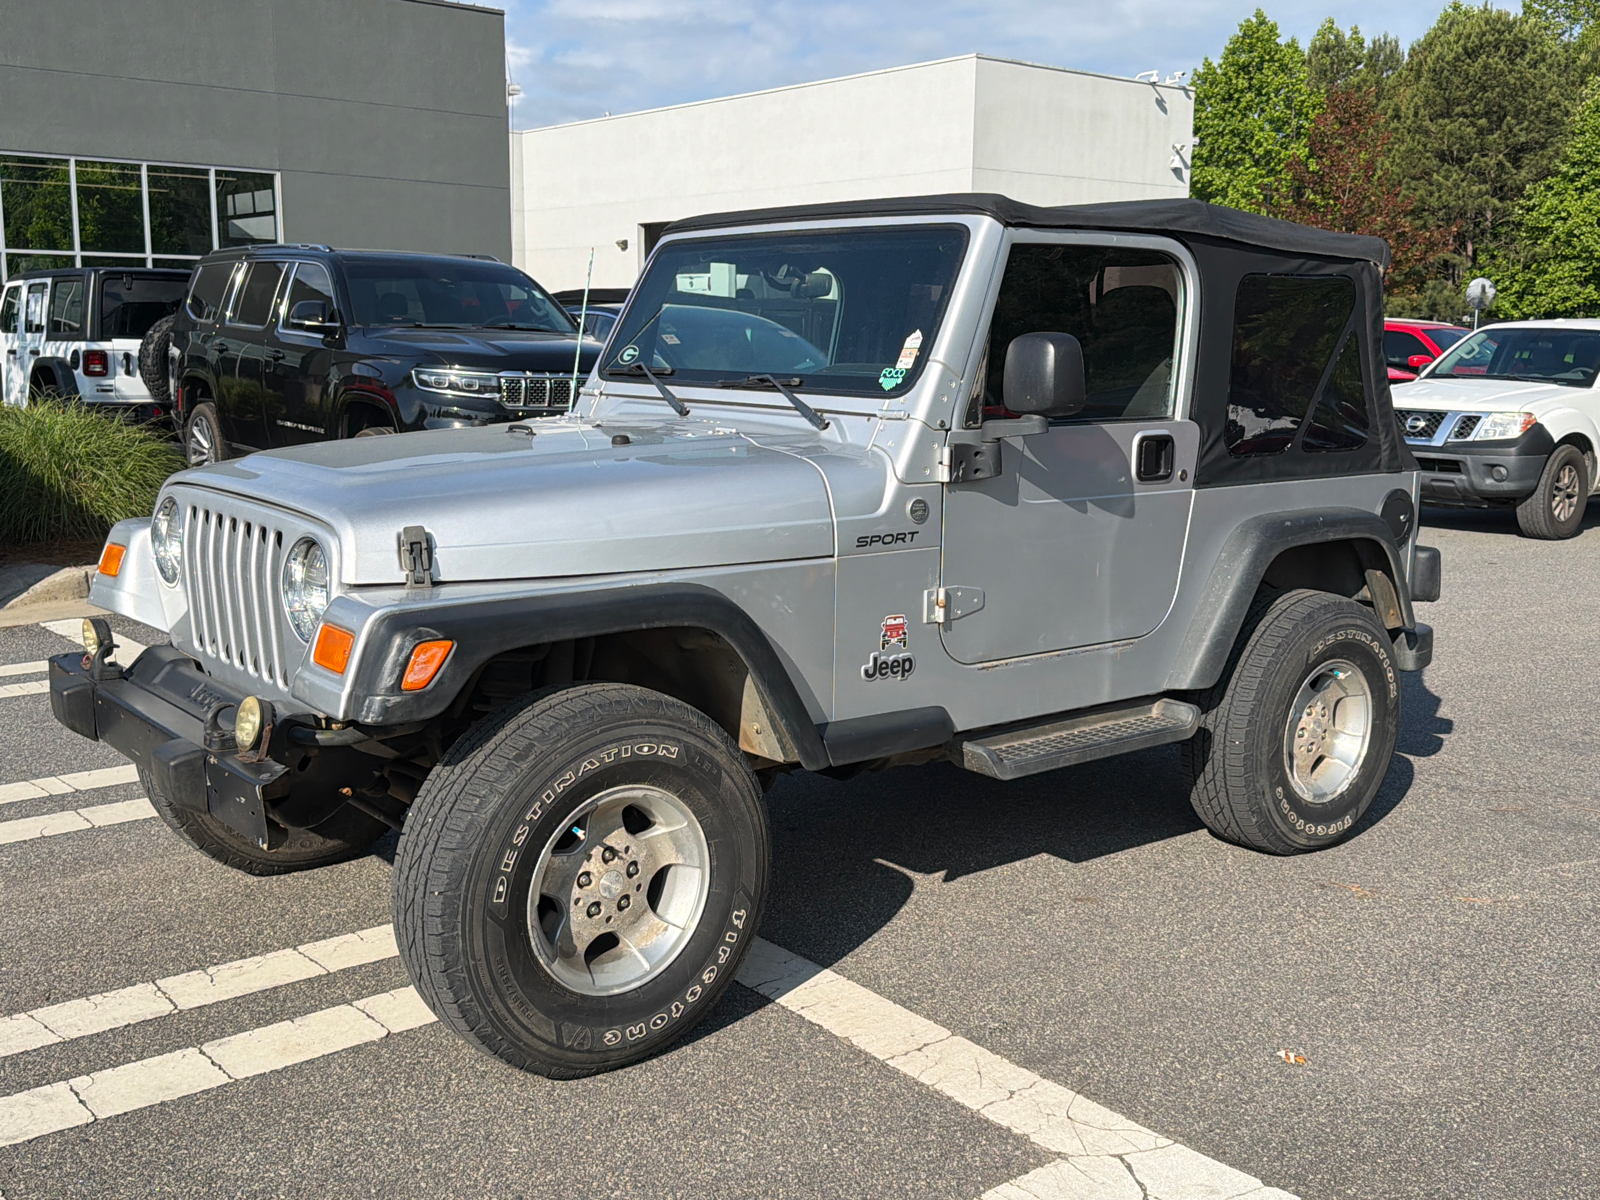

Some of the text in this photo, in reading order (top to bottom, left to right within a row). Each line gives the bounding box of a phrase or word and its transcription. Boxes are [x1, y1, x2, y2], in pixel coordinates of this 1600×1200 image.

[880, 368, 906, 378] FOCO
[855, 531, 919, 548] SPORT
[862, 654, 914, 681] Jeep
[1313, 630, 1397, 698] DESTINATION
[494, 743, 679, 902] DESTINATION
